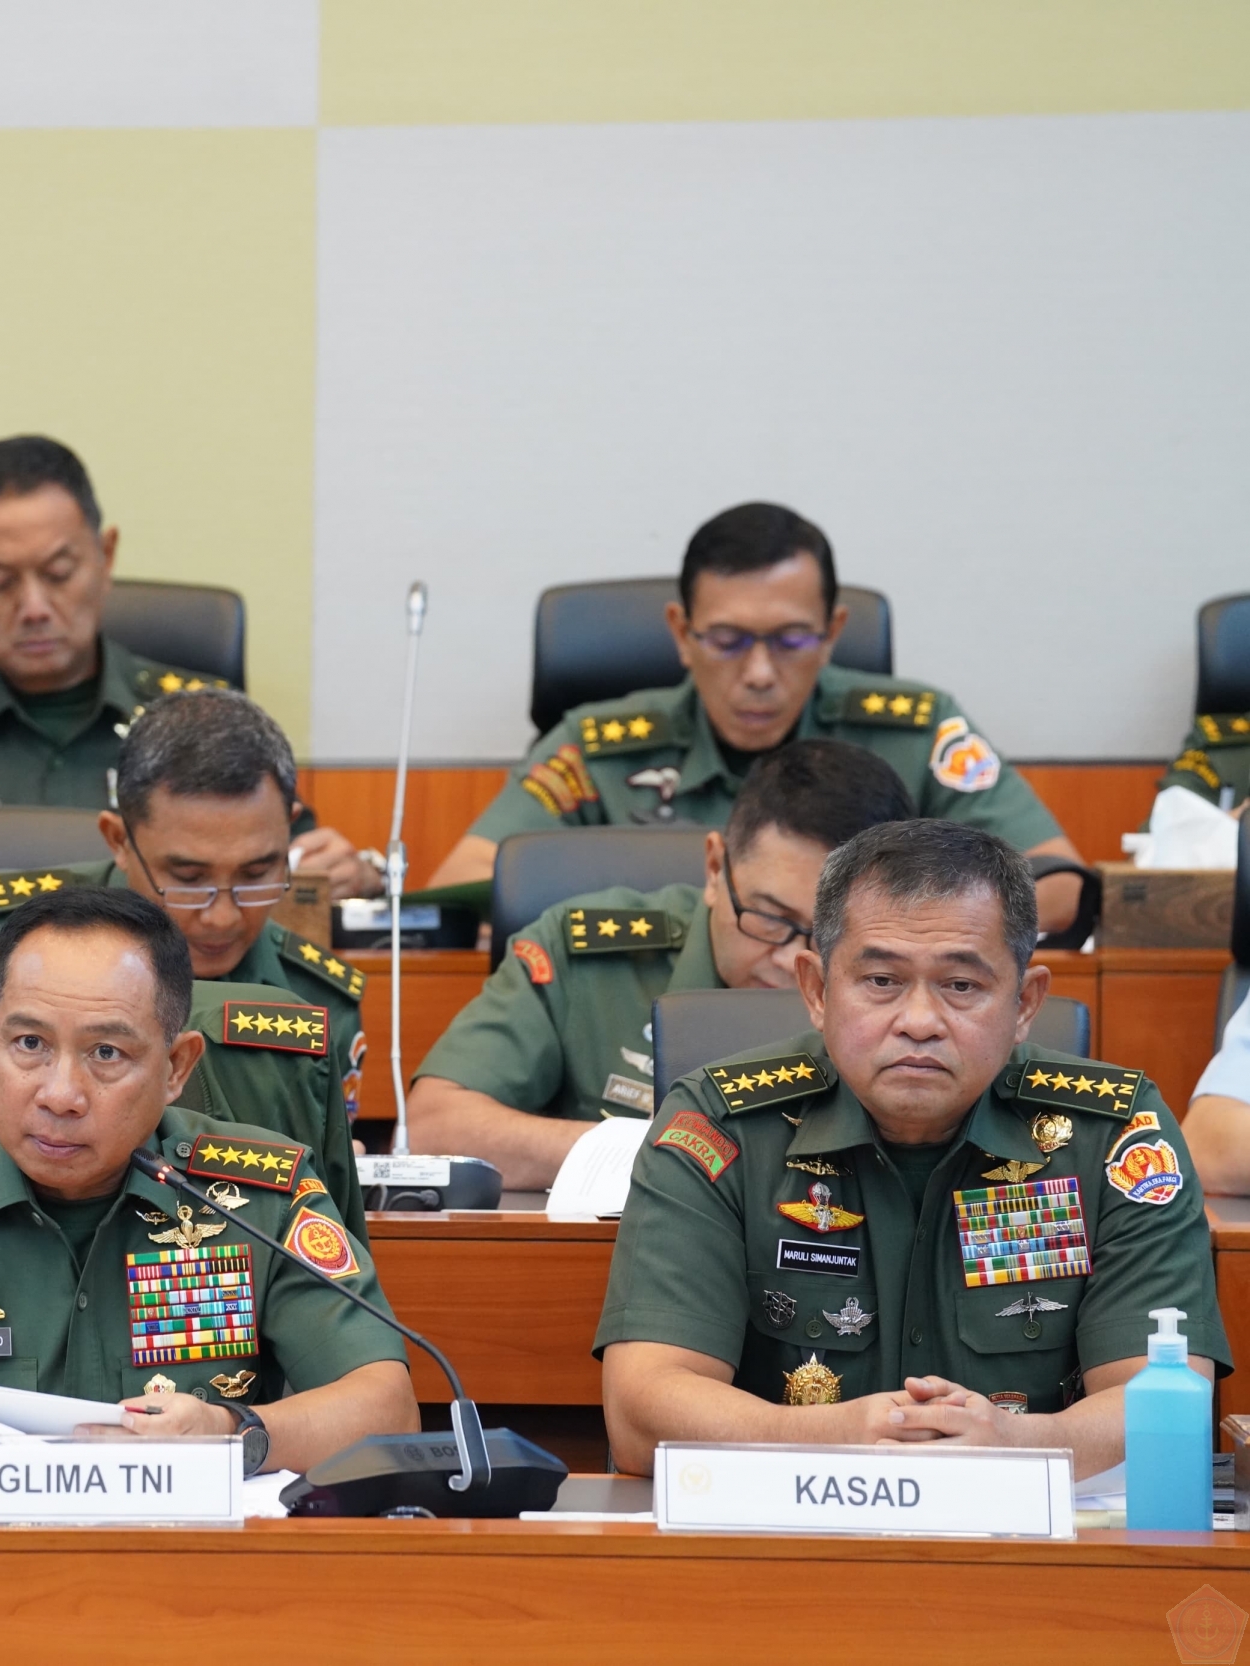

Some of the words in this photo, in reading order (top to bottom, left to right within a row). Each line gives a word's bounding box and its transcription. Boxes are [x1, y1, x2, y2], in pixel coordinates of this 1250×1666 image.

[570, 910, 588, 948] TNI
[310, 1012, 325, 1049] TNI
[713, 1069, 744, 1106] TNI
[1114, 1073, 1138, 1111] TNI
[276, 1150, 298, 1184] TNI
[669, 1131, 717, 1168] CAKRA
[784, 1249, 809, 1261] MARULI
[810, 1253, 857, 1267] SIMANJUNTAK
[119, 1464, 172, 1491] TNI
[795, 1475, 921, 1507] KASAD
